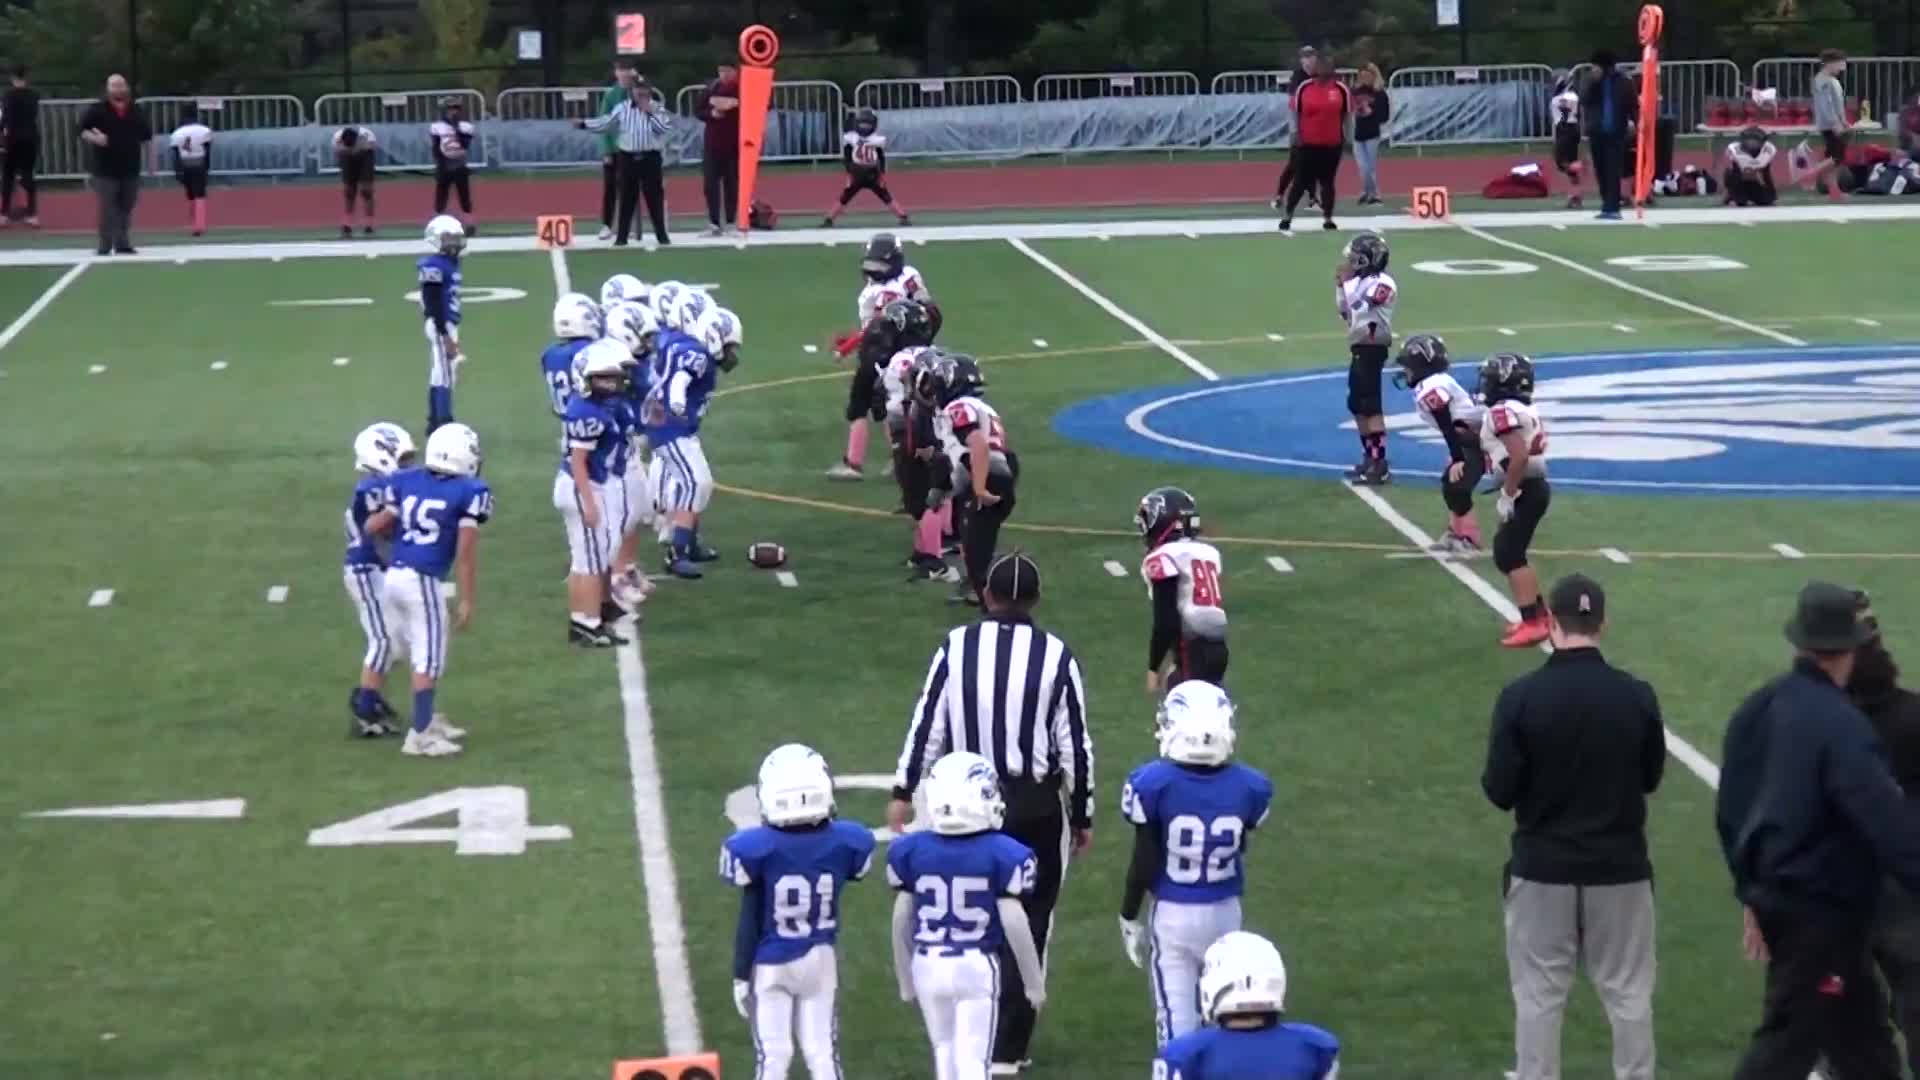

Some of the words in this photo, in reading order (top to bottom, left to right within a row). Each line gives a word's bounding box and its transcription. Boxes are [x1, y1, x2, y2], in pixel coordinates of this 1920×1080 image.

[541, 219, 569, 246] 40
[1418, 190, 1445, 218] 50
[402, 495, 447, 545] 15
[1191, 558, 1222, 608] 80
[307, 786, 573, 856] 4
[1166, 814, 1244, 884] 82
[774, 873, 836, 938] 81
[914, 875, 990, 942] 25
